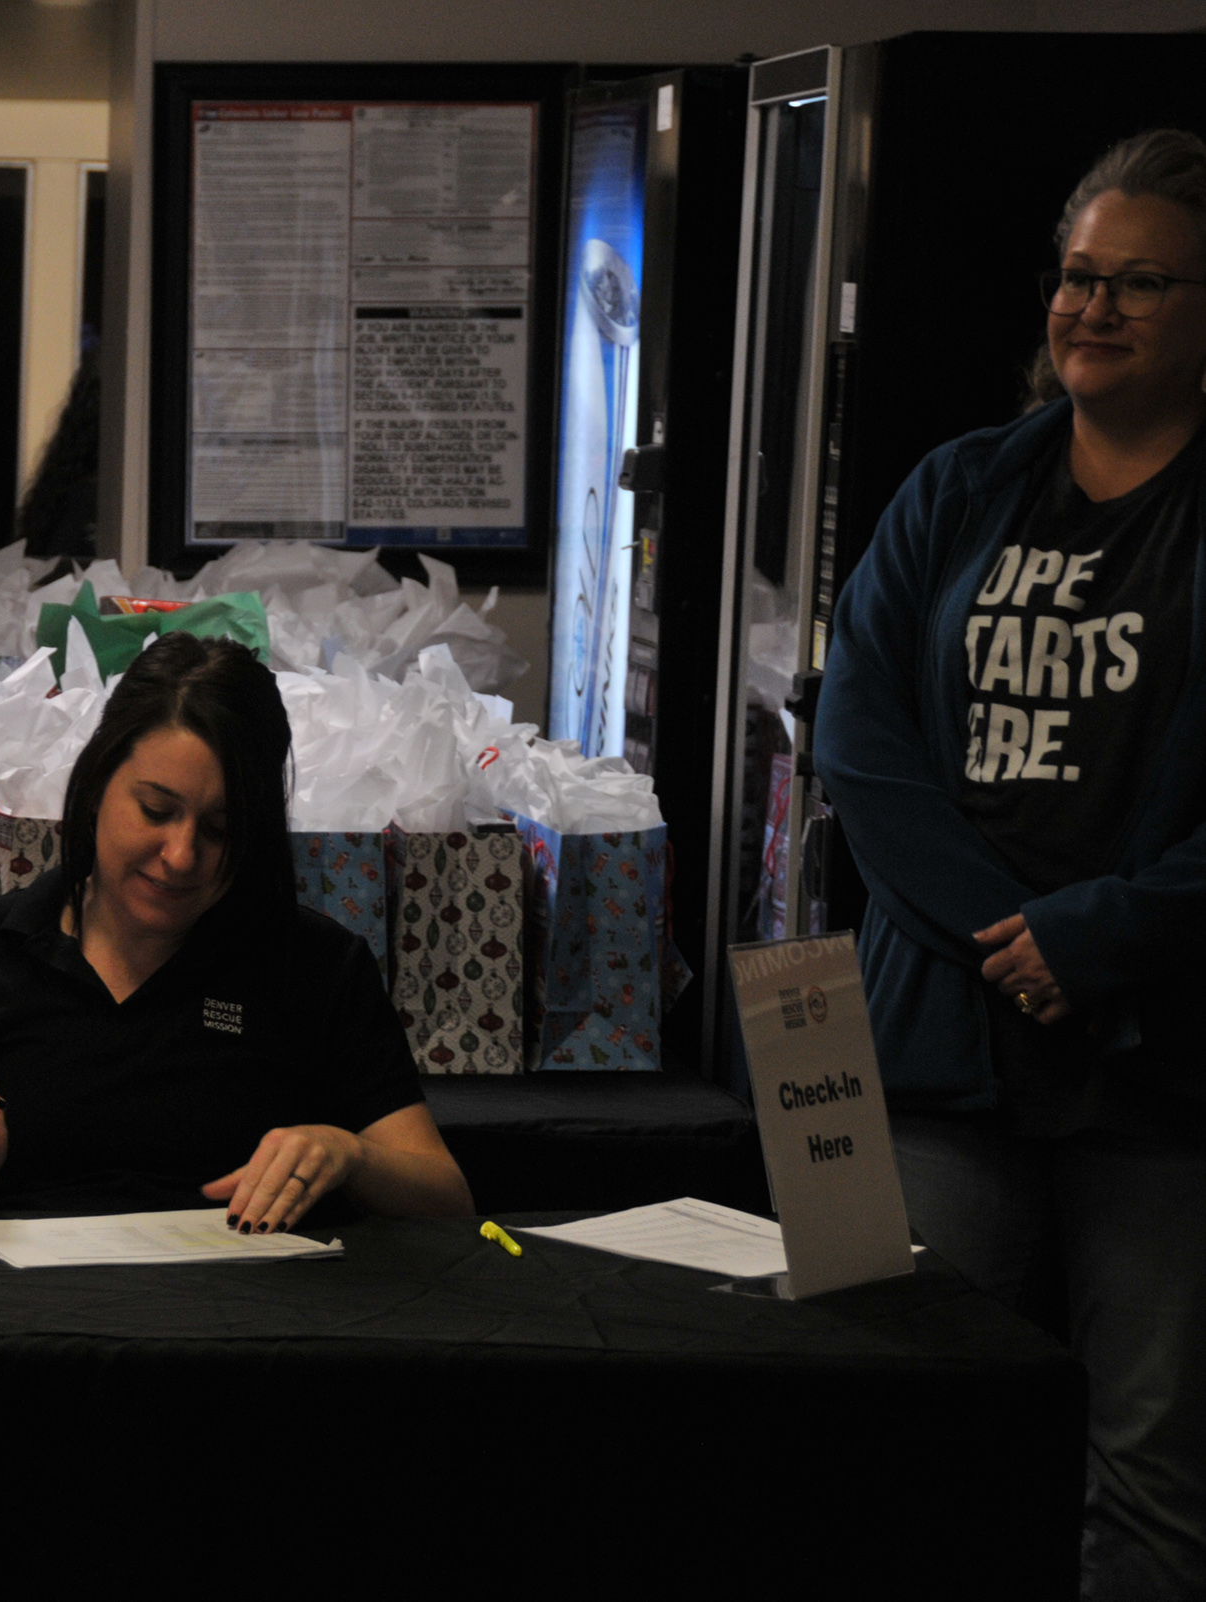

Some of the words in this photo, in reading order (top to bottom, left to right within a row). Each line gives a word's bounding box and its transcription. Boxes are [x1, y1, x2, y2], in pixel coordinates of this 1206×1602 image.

[976, 543, 1104, 613] OPE
[965, 610, 1145, 699] TARTS
[202, 1008, 242, 1024] RESCUE
[204, 997, 244, 1013] DENVER
[203, 1020, 243, 1035] MISSION
[778, 1070, 863, 1111] Check-In
[807, 1134, 854, 1164] Here
